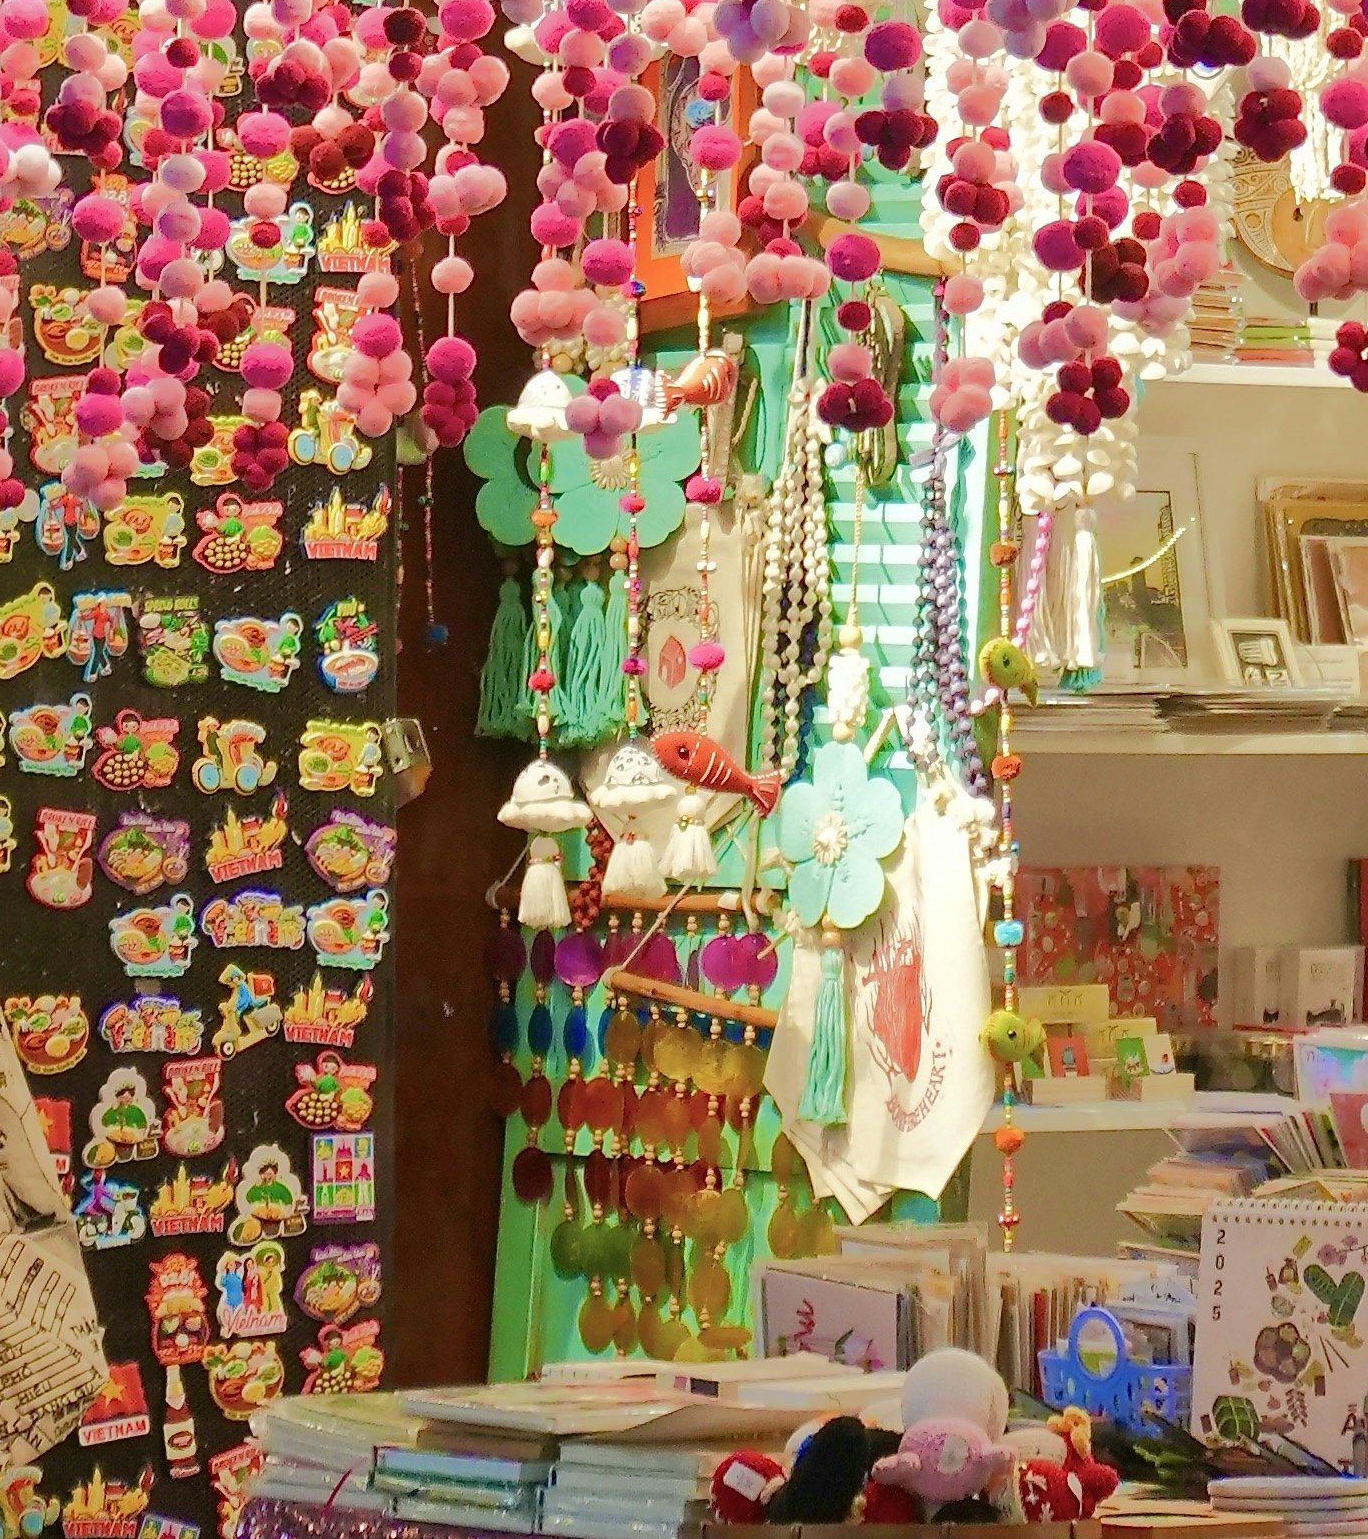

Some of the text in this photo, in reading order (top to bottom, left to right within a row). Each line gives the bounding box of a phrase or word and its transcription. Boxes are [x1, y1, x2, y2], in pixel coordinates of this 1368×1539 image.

[306, 541, 377, 560] VIETNAM
[209, 850, 283, 883] VIETNAM
[285, 1024, 354, 1047] VIETNAM
[152, 1213, 224, 1237] VIETNAM
[222, 1309, 286, 1335] Vietnam
[83, 1420, 148, 1444] VIETNAM
[65, 1520, 136, 1539] VIETNAM
